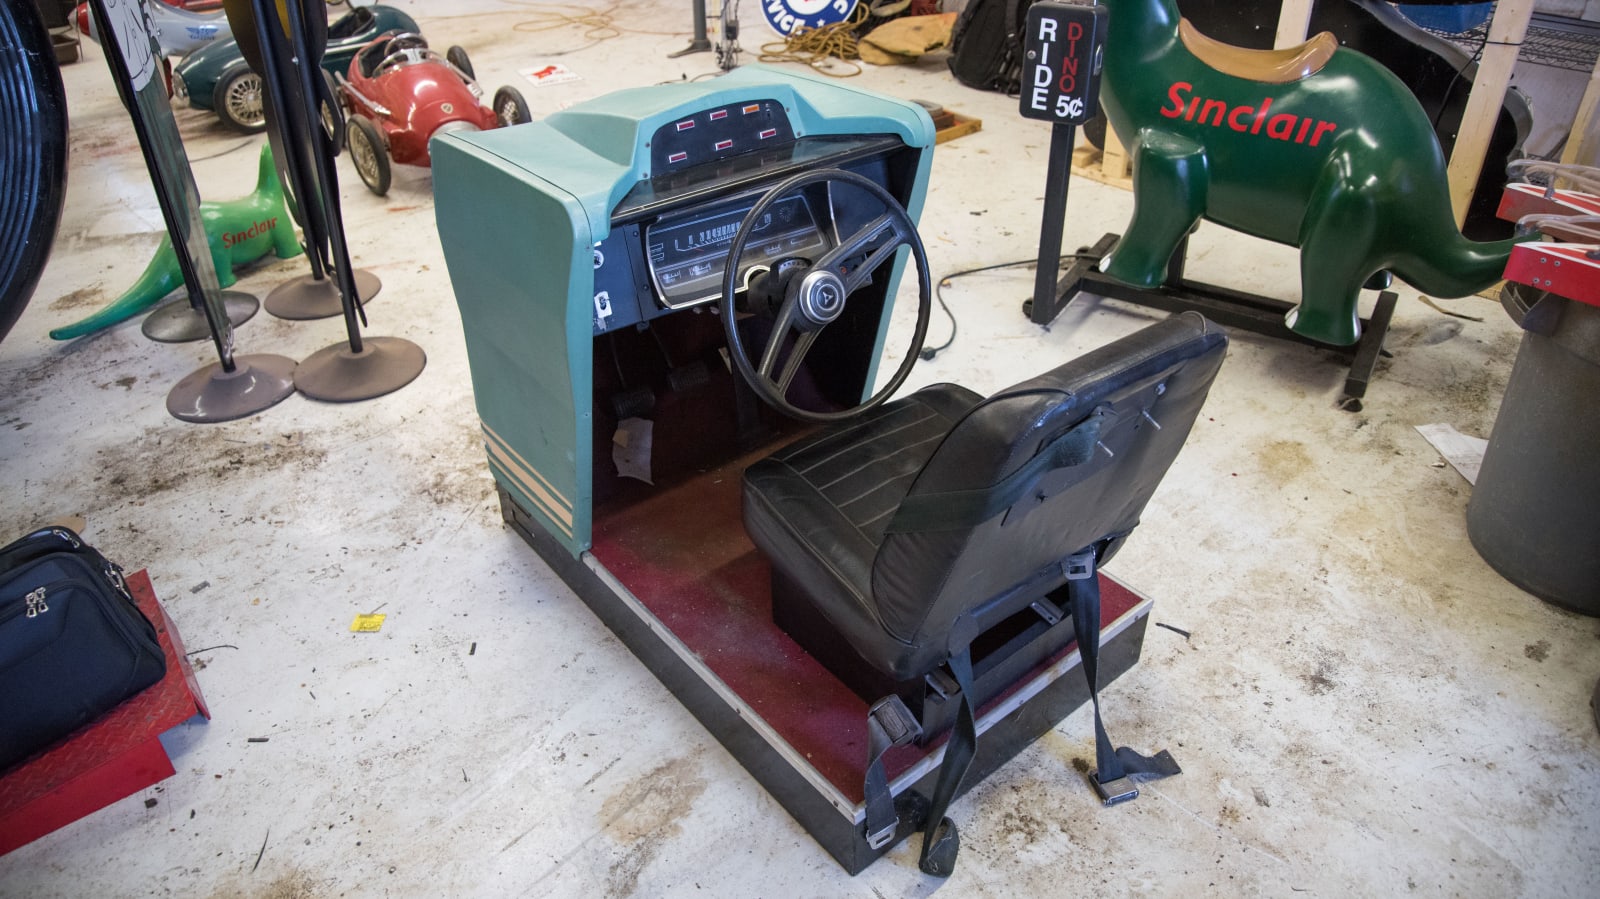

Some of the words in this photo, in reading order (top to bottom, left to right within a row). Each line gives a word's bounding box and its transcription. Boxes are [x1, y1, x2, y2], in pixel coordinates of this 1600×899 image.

[765, 0, 806, 36] VICE
[1031, 17, 1058, 111] RIDE
[1058, 21, 1083, 93] DINO
[1055, 95, 1083, 119] 5¢
[1159, 81, 1337, 147] Sinclair
[222, 217, 278, 249] Sinclair
